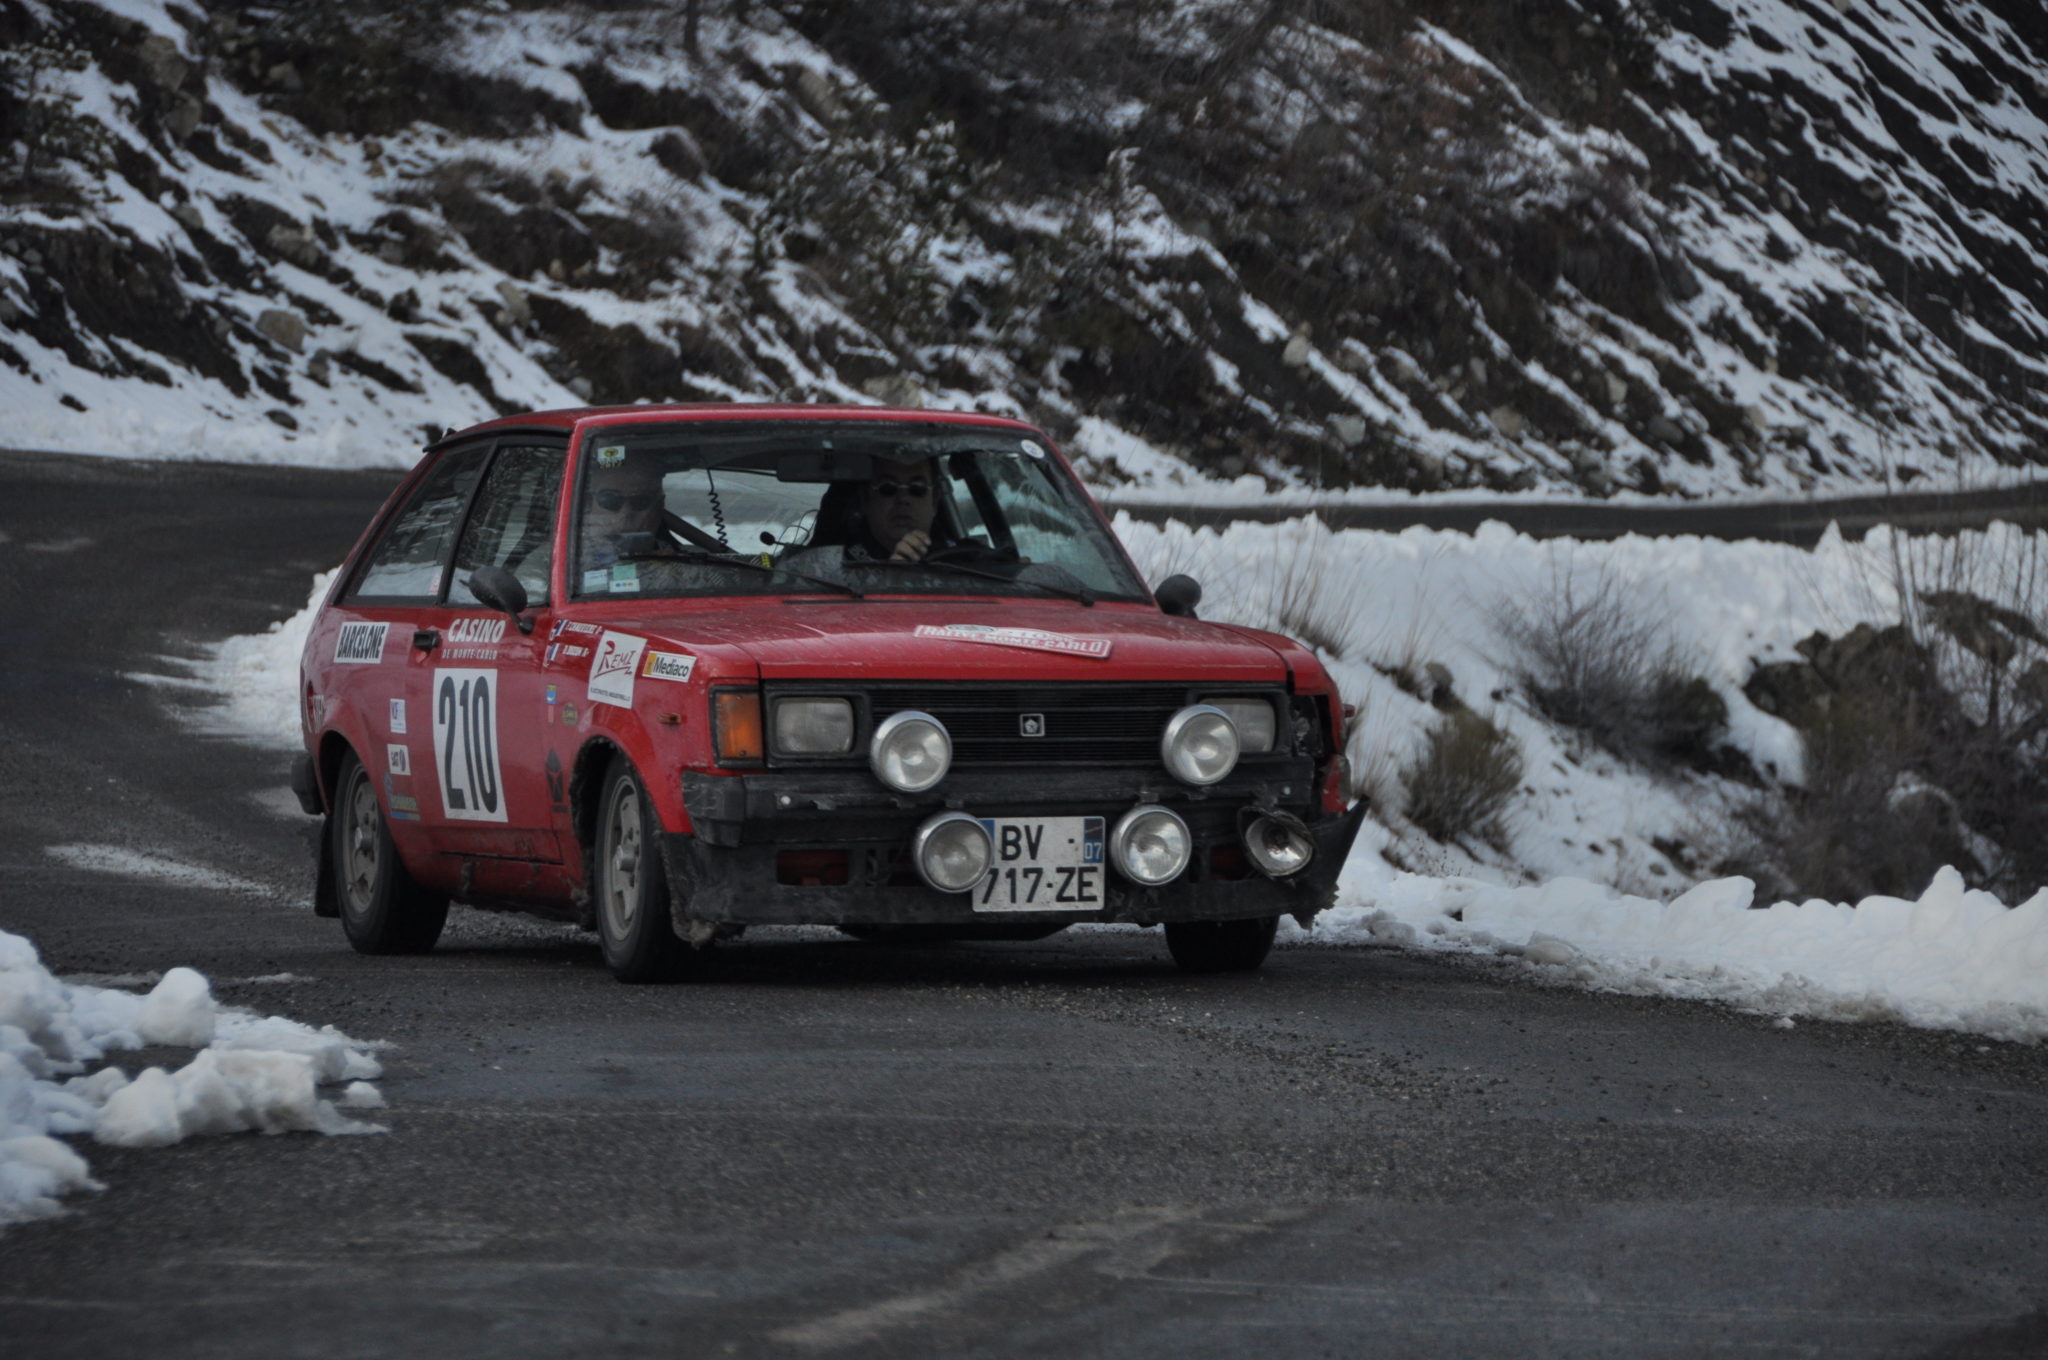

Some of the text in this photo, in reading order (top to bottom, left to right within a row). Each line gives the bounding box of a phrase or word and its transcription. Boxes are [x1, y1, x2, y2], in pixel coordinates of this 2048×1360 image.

[337, 625, 386, 658] BARCELONE
[447, 618, 506, 643] CASINO
[442, 648, 450, 658] DE
[653, 657, 689, 677] Mediaco
[438, 676, 498, 814] 210
[1084, 842, 1102, 859] 07
